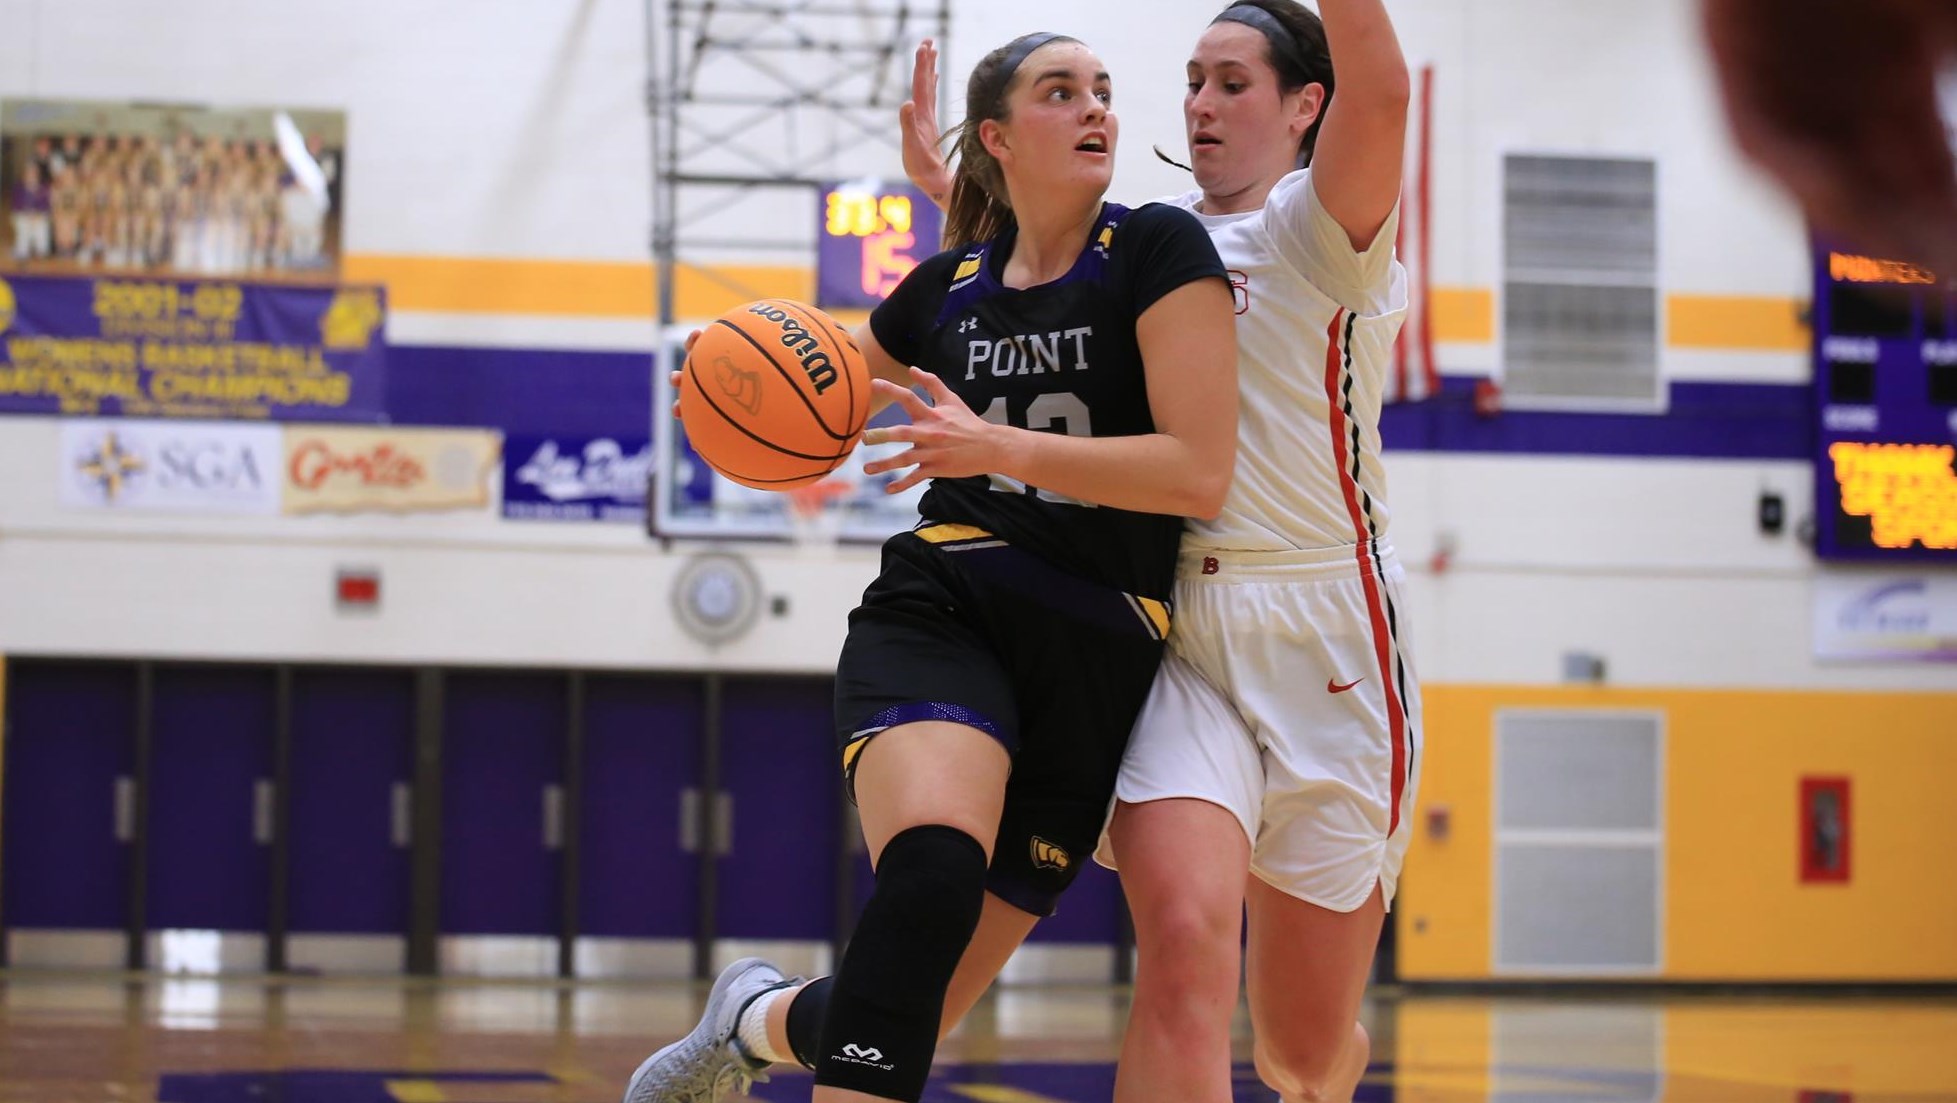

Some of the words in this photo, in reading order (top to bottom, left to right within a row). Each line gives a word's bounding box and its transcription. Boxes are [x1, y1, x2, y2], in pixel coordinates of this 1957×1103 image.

[748, 303, 838, 396] Wilson
[965, 325, 1093, 381] POINT
[158, 444, 263, 489] SGA
[1201, 556, 1219, 575] B
